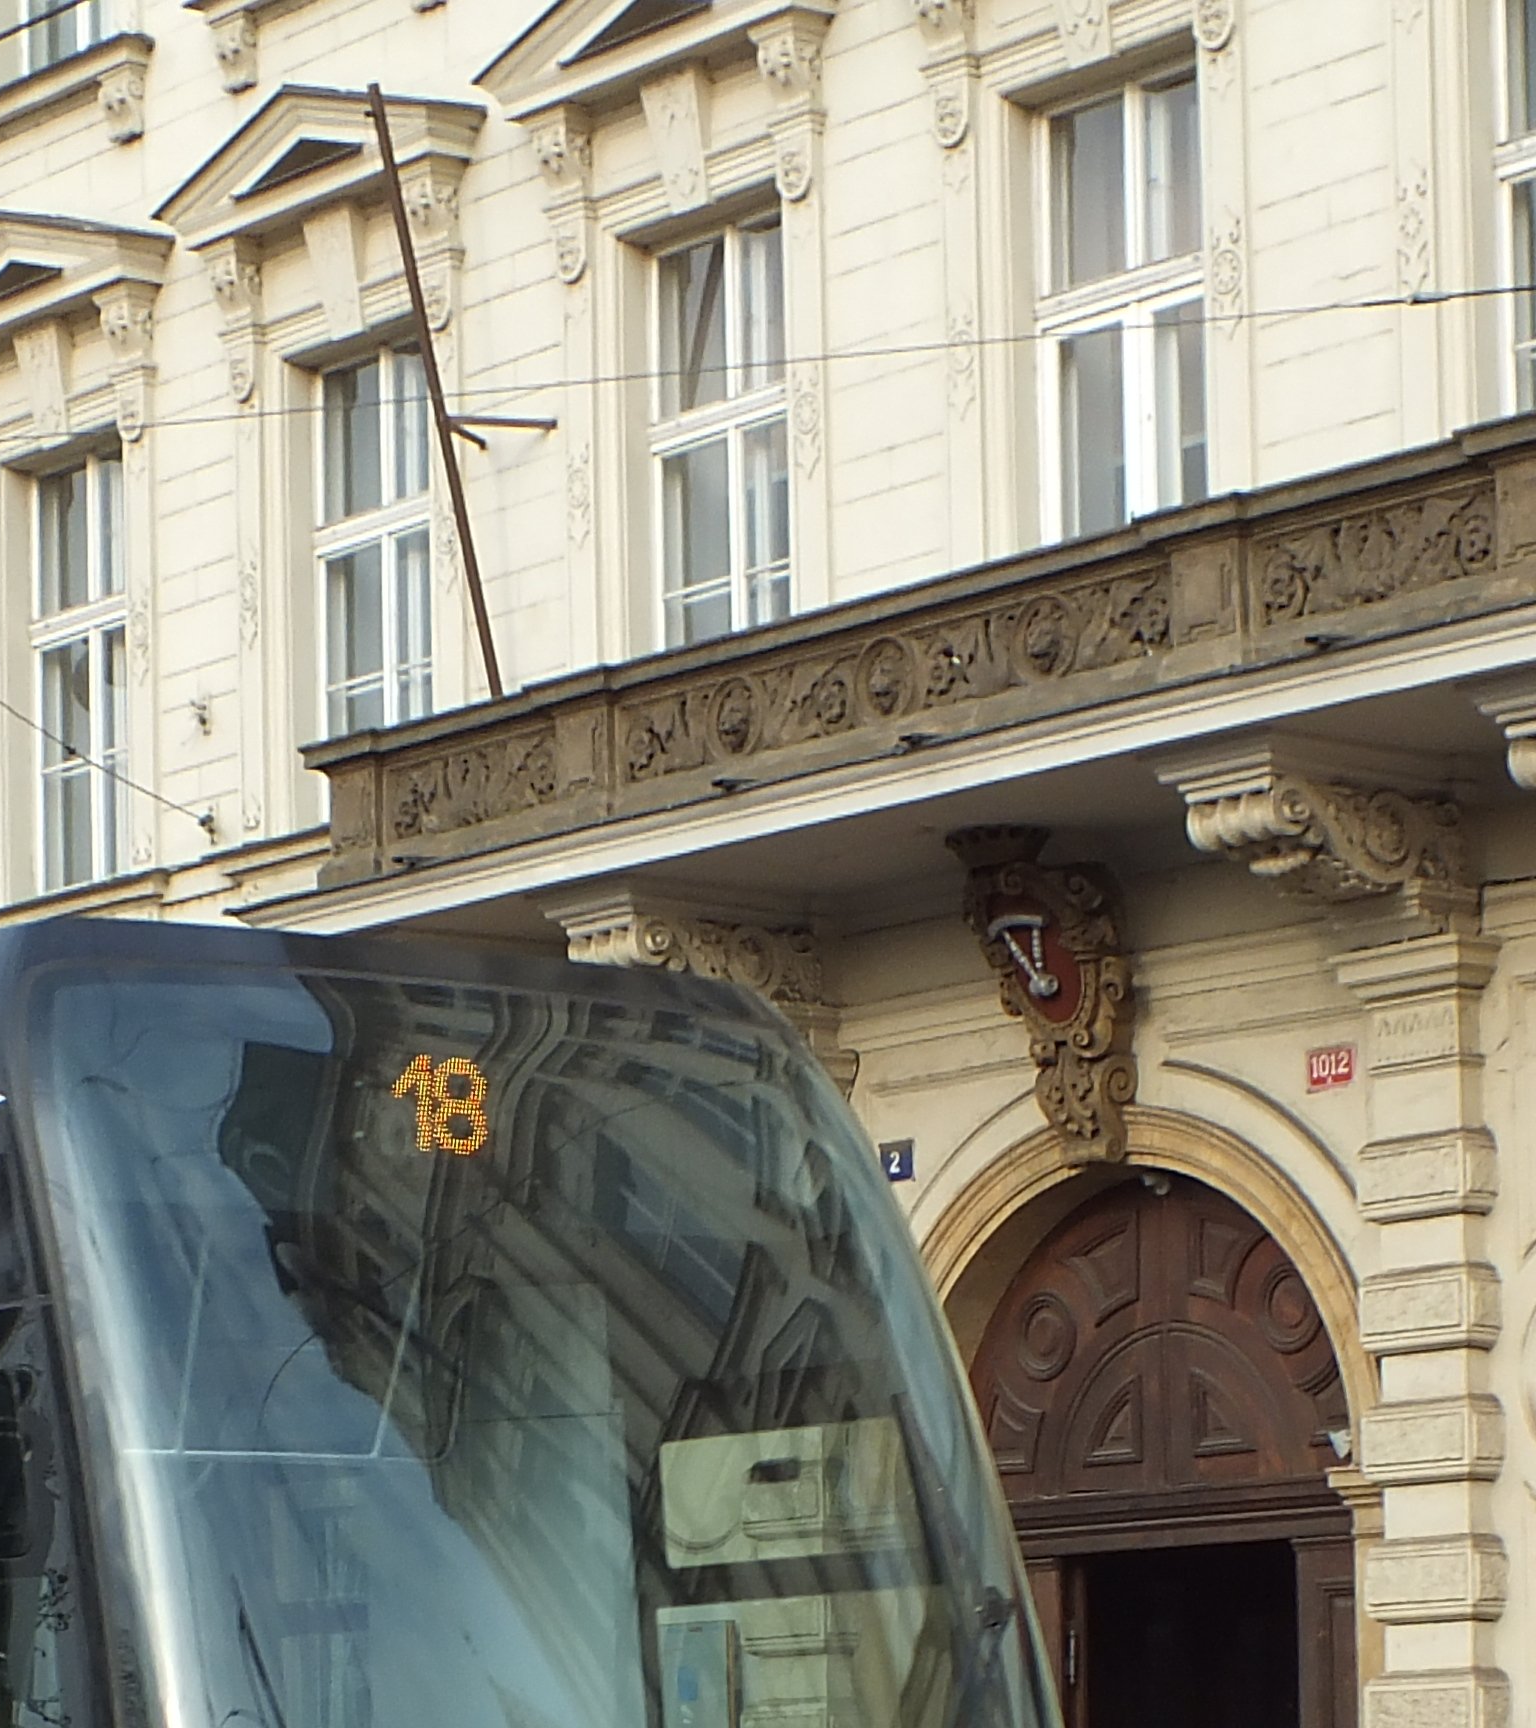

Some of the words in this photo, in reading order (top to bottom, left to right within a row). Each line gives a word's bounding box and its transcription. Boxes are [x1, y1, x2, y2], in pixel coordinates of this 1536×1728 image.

[1310, 1050, 1350, 1079] 1012
[392, 1053, 489, 1157] 18
[889, 1150, 901, 1174] 2
